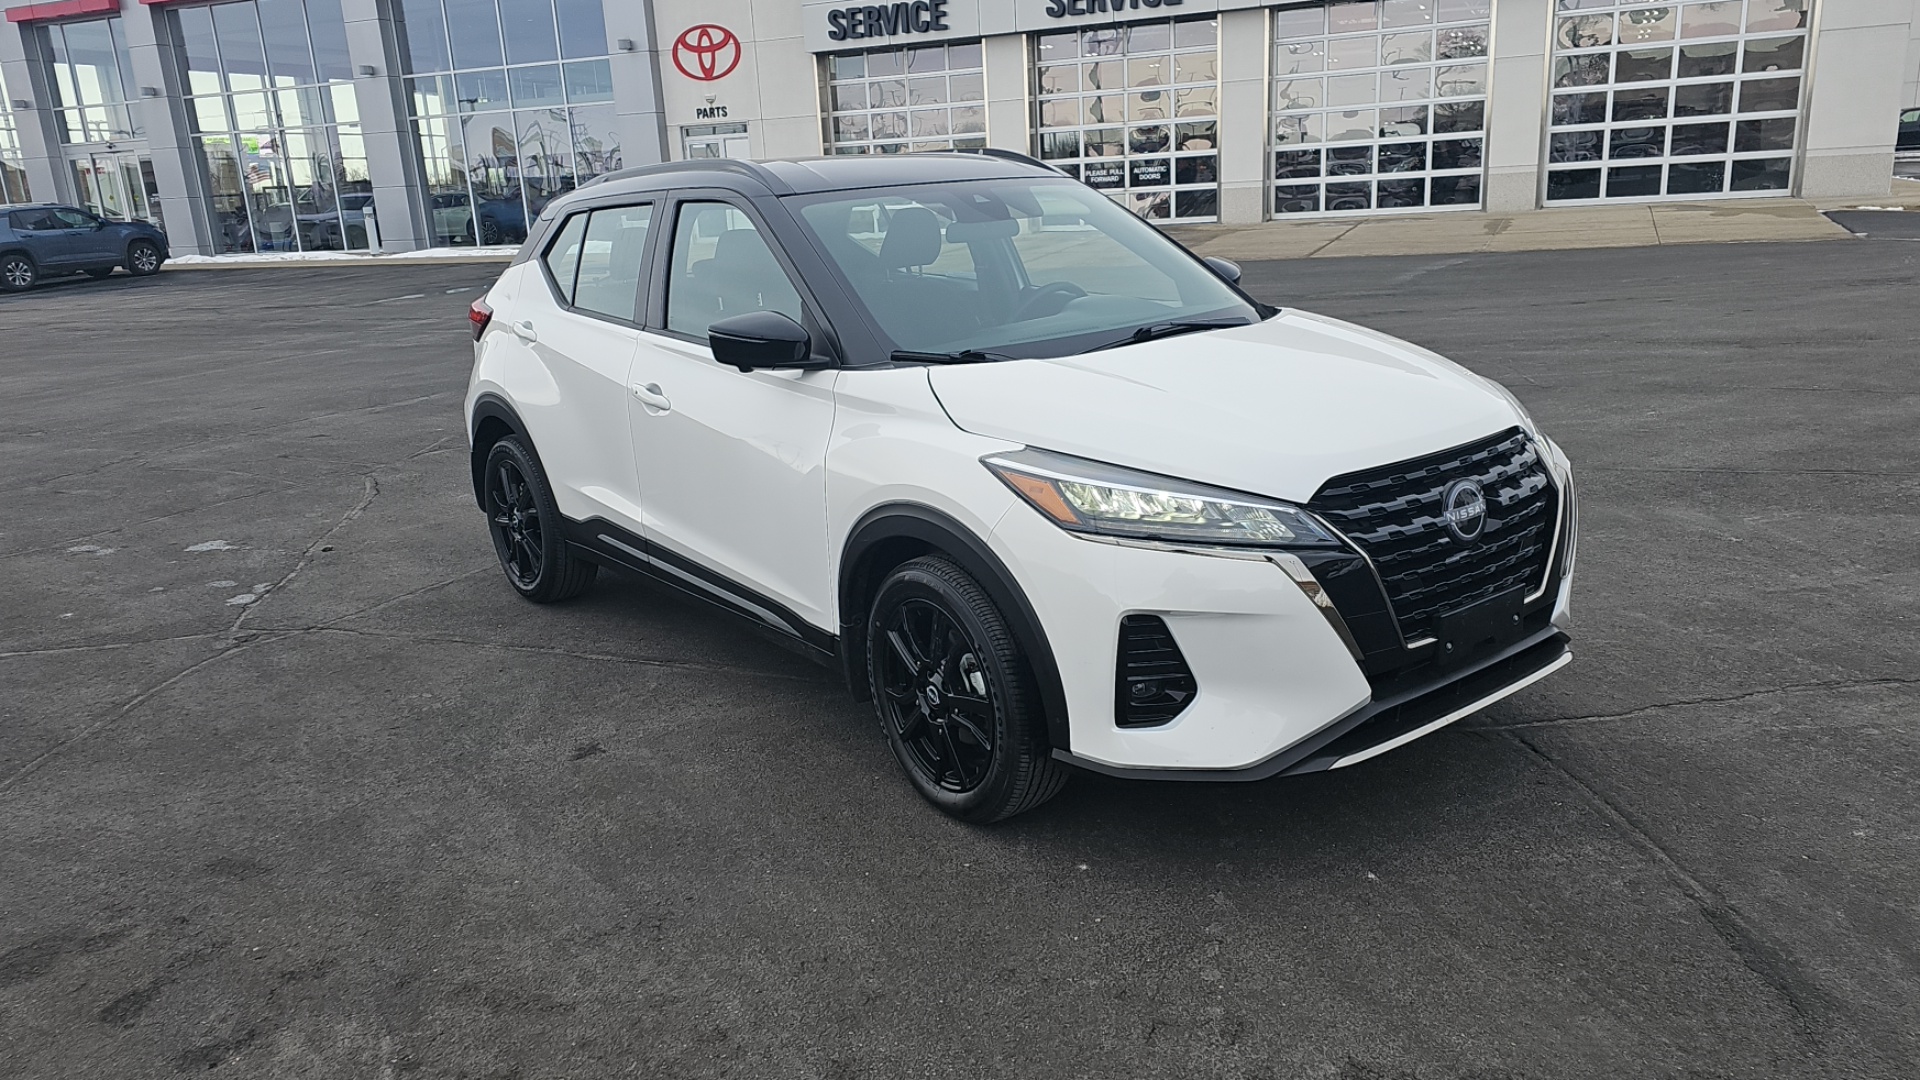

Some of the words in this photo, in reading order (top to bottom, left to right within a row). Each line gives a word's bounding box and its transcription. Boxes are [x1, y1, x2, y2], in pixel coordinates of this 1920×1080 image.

[827, 0, 949, 41] SERVICE
[696, 106, 728, 119] PARTS
[1085, 169, 1108, 177] PLEASE
[1109, 167, 1124, 175] PULL
[1133, 165, 1167, 174] AUTOMATIC
[1090, 175, 1120, 183] FORWARD
[1446, 503, 1486, 522] NISSAN
